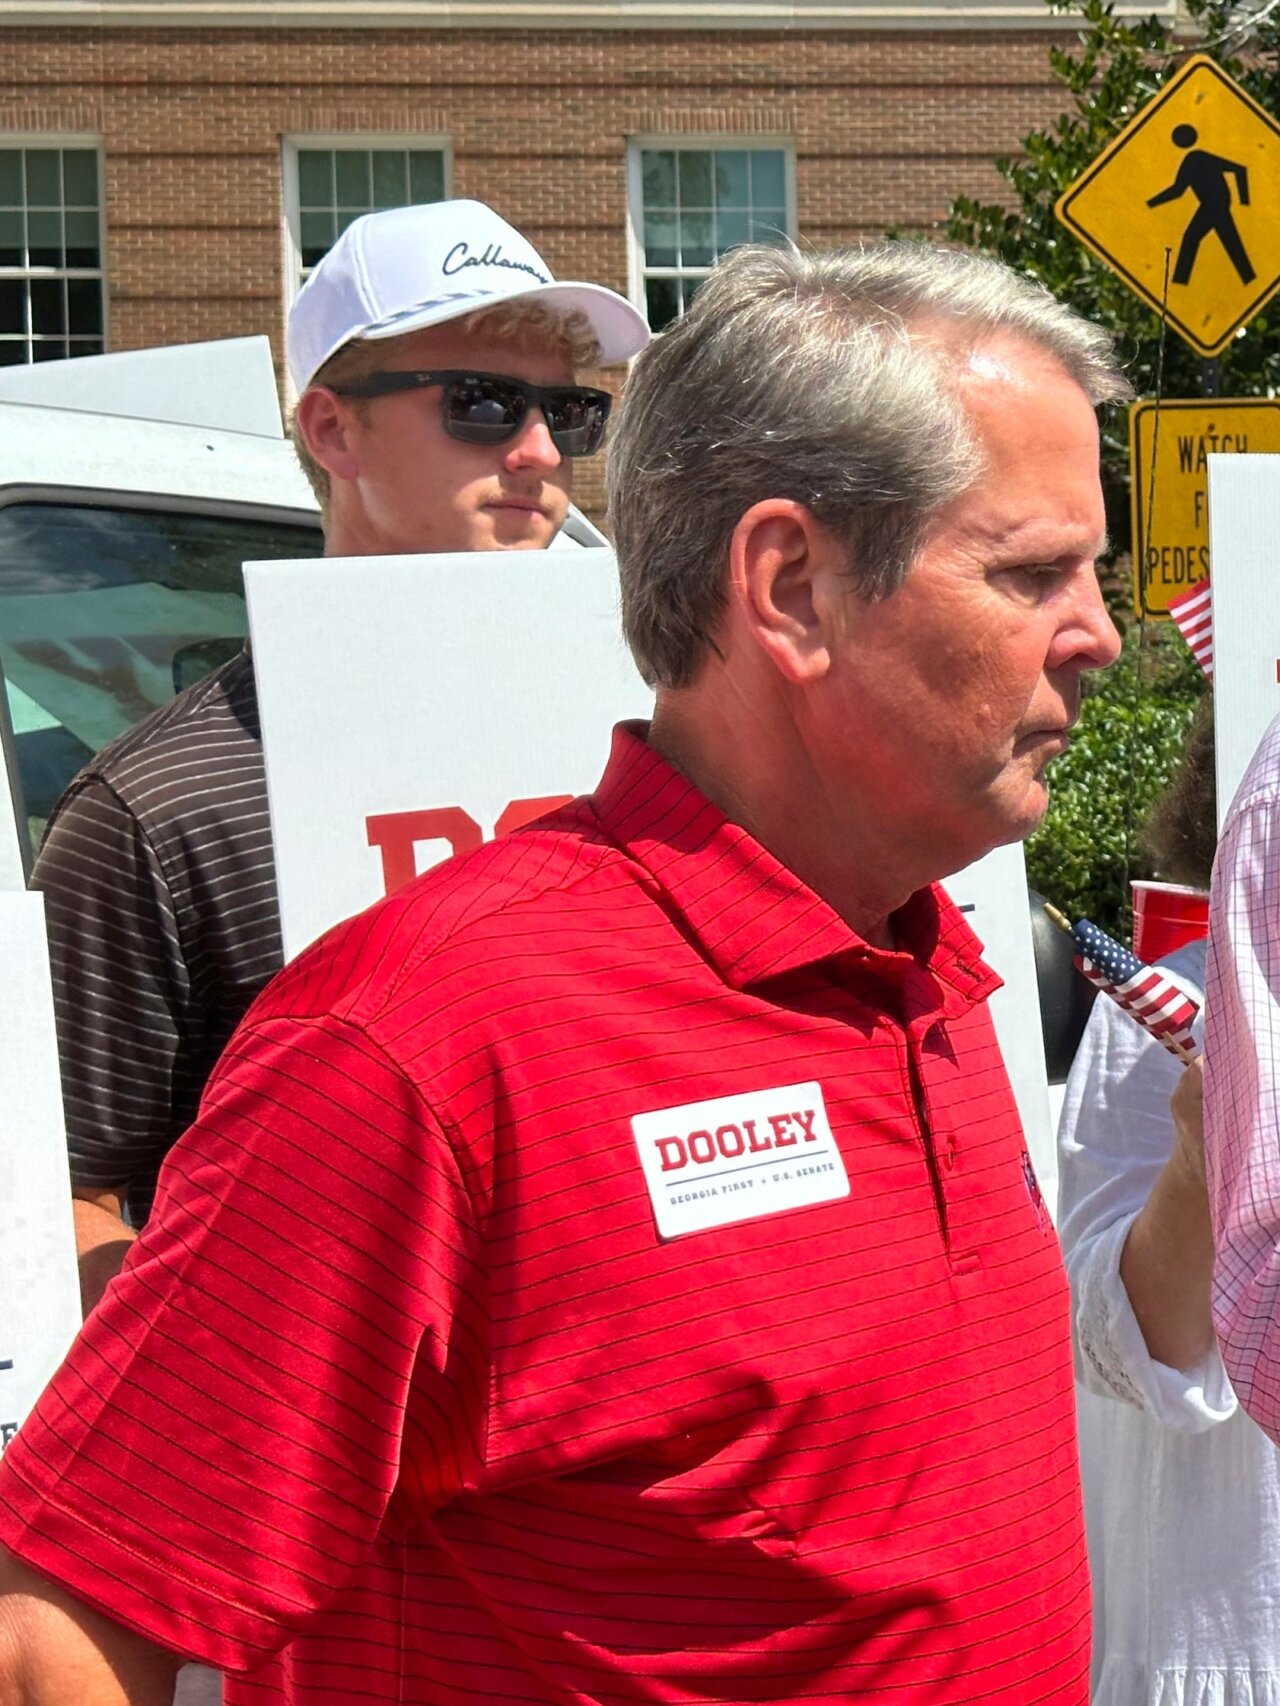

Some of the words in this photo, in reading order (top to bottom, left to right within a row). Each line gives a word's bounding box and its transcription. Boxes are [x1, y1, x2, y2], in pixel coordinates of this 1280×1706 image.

[654, 1109, 818, 1172] DOOLEY
[670, 1188, 718, 1205] GEORGIA
[721, 1179, 754, 1194] FIRST
[773, 1173, 793, 1183] U.S.
[797, 1163, 835, 1177] SENATE
